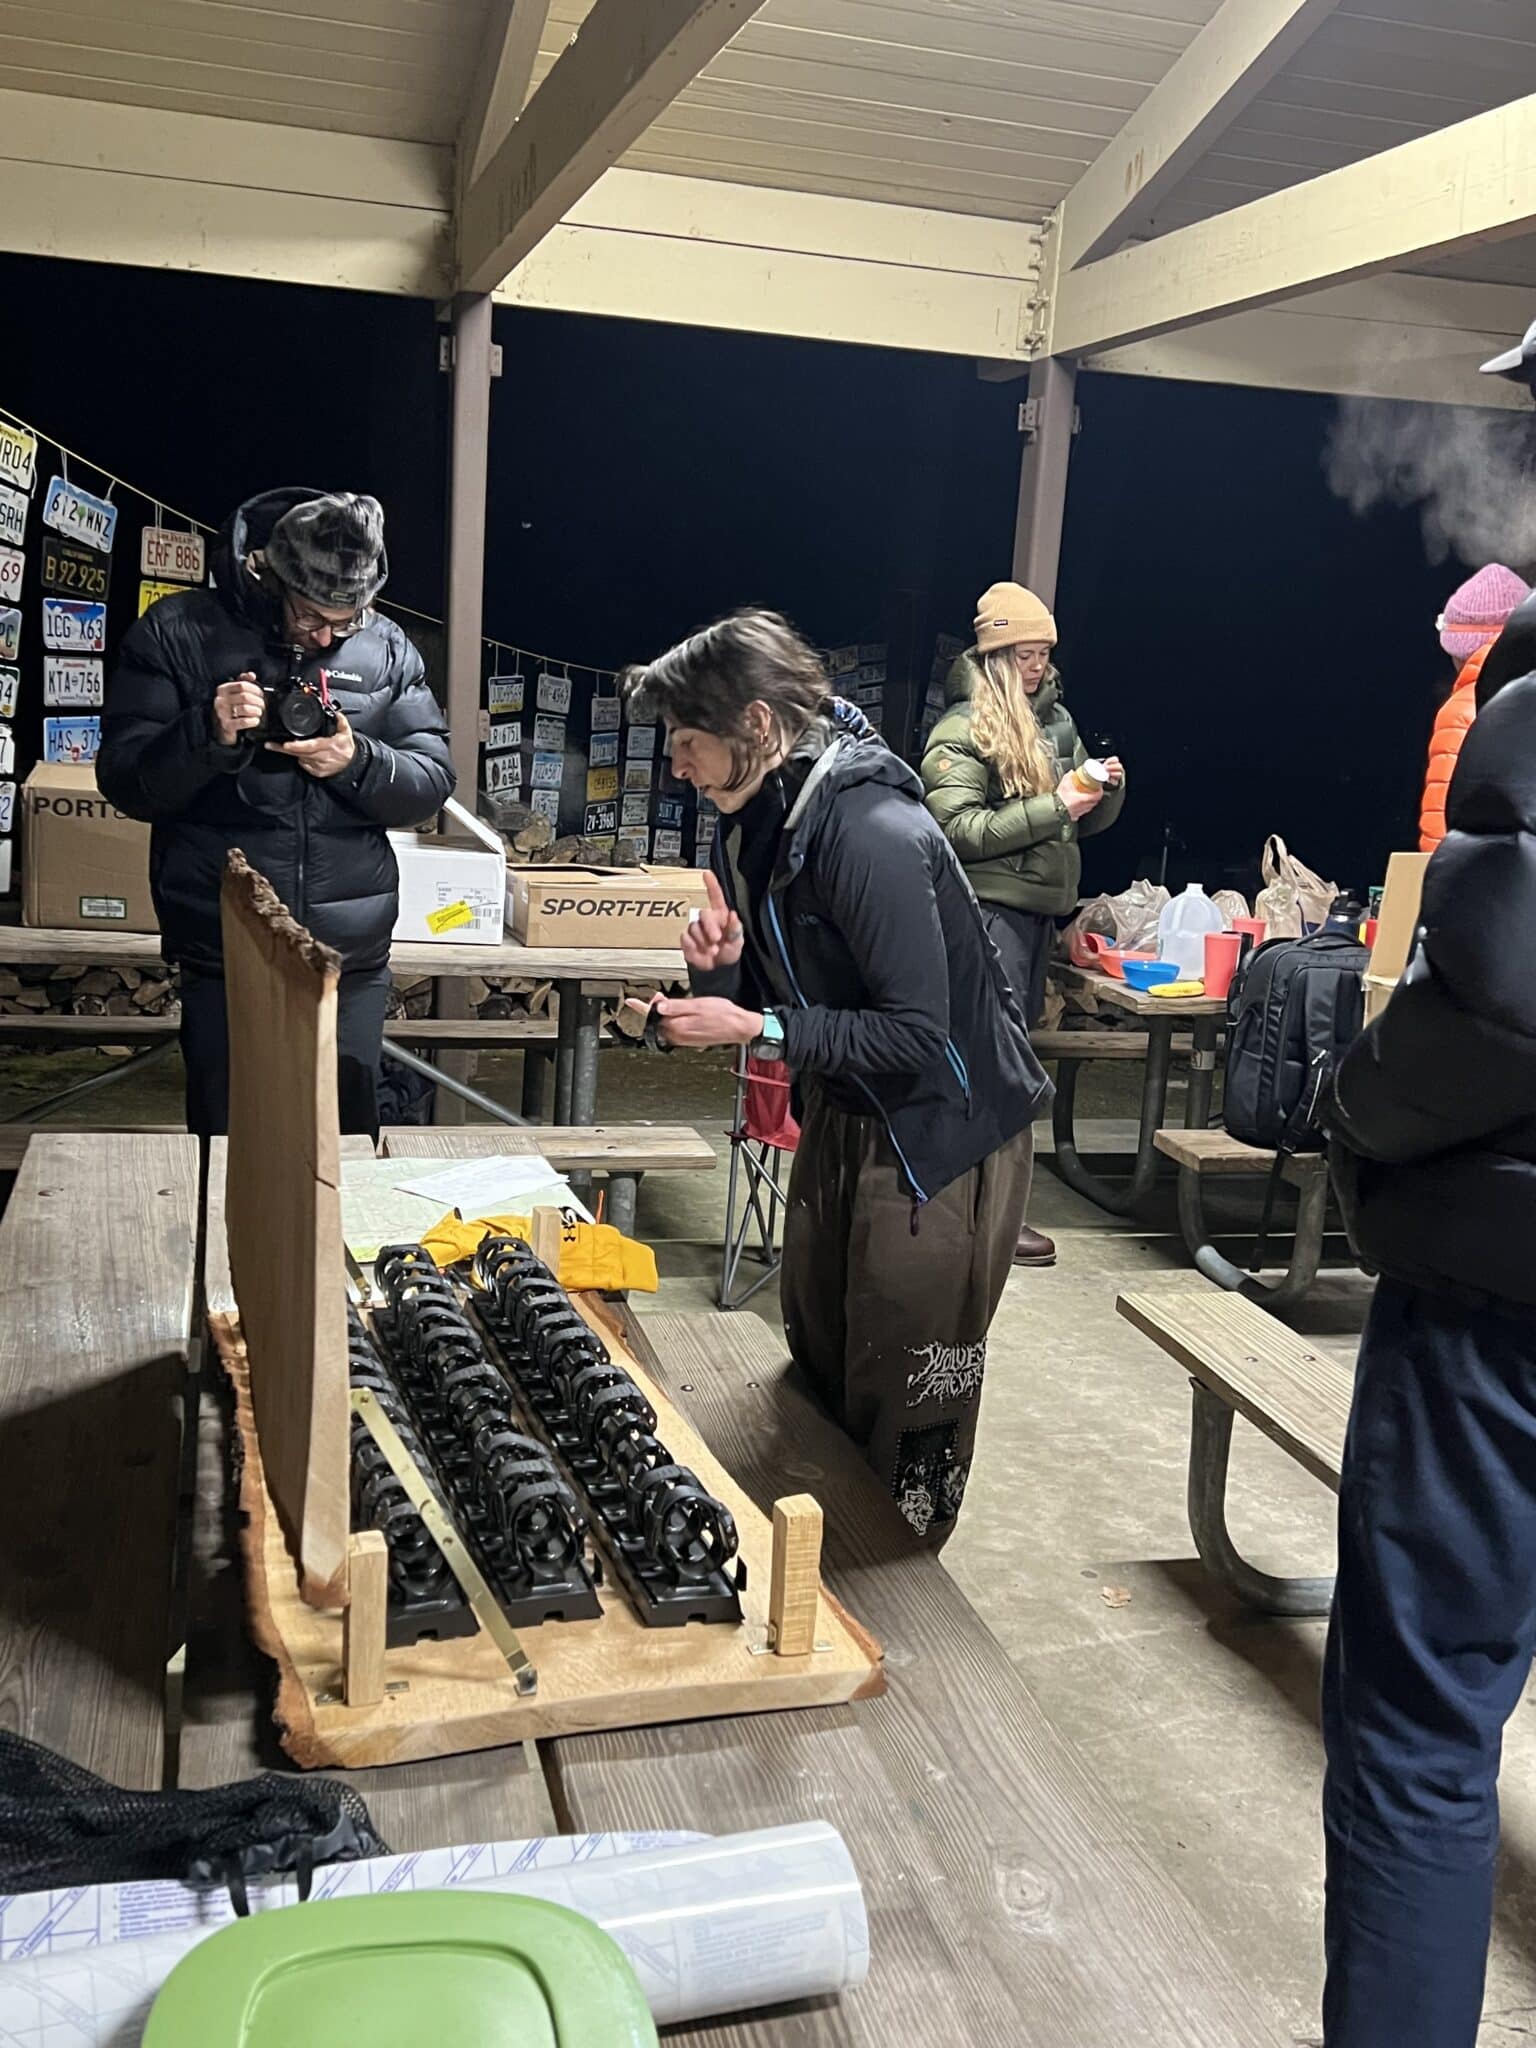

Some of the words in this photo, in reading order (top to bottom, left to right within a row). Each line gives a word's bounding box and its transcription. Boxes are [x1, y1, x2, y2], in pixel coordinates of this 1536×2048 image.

[51, 493, 78, 521] 612
[86, 508, 111, 538] WNZ
[147, 540, 172, 567] ERF
[175, 545, 200, 571] 886
[79, 616, 103, 640] X63
[48, 729, 72, 752] HAS
[540, 898, 686, 917] SPORT-TEK
